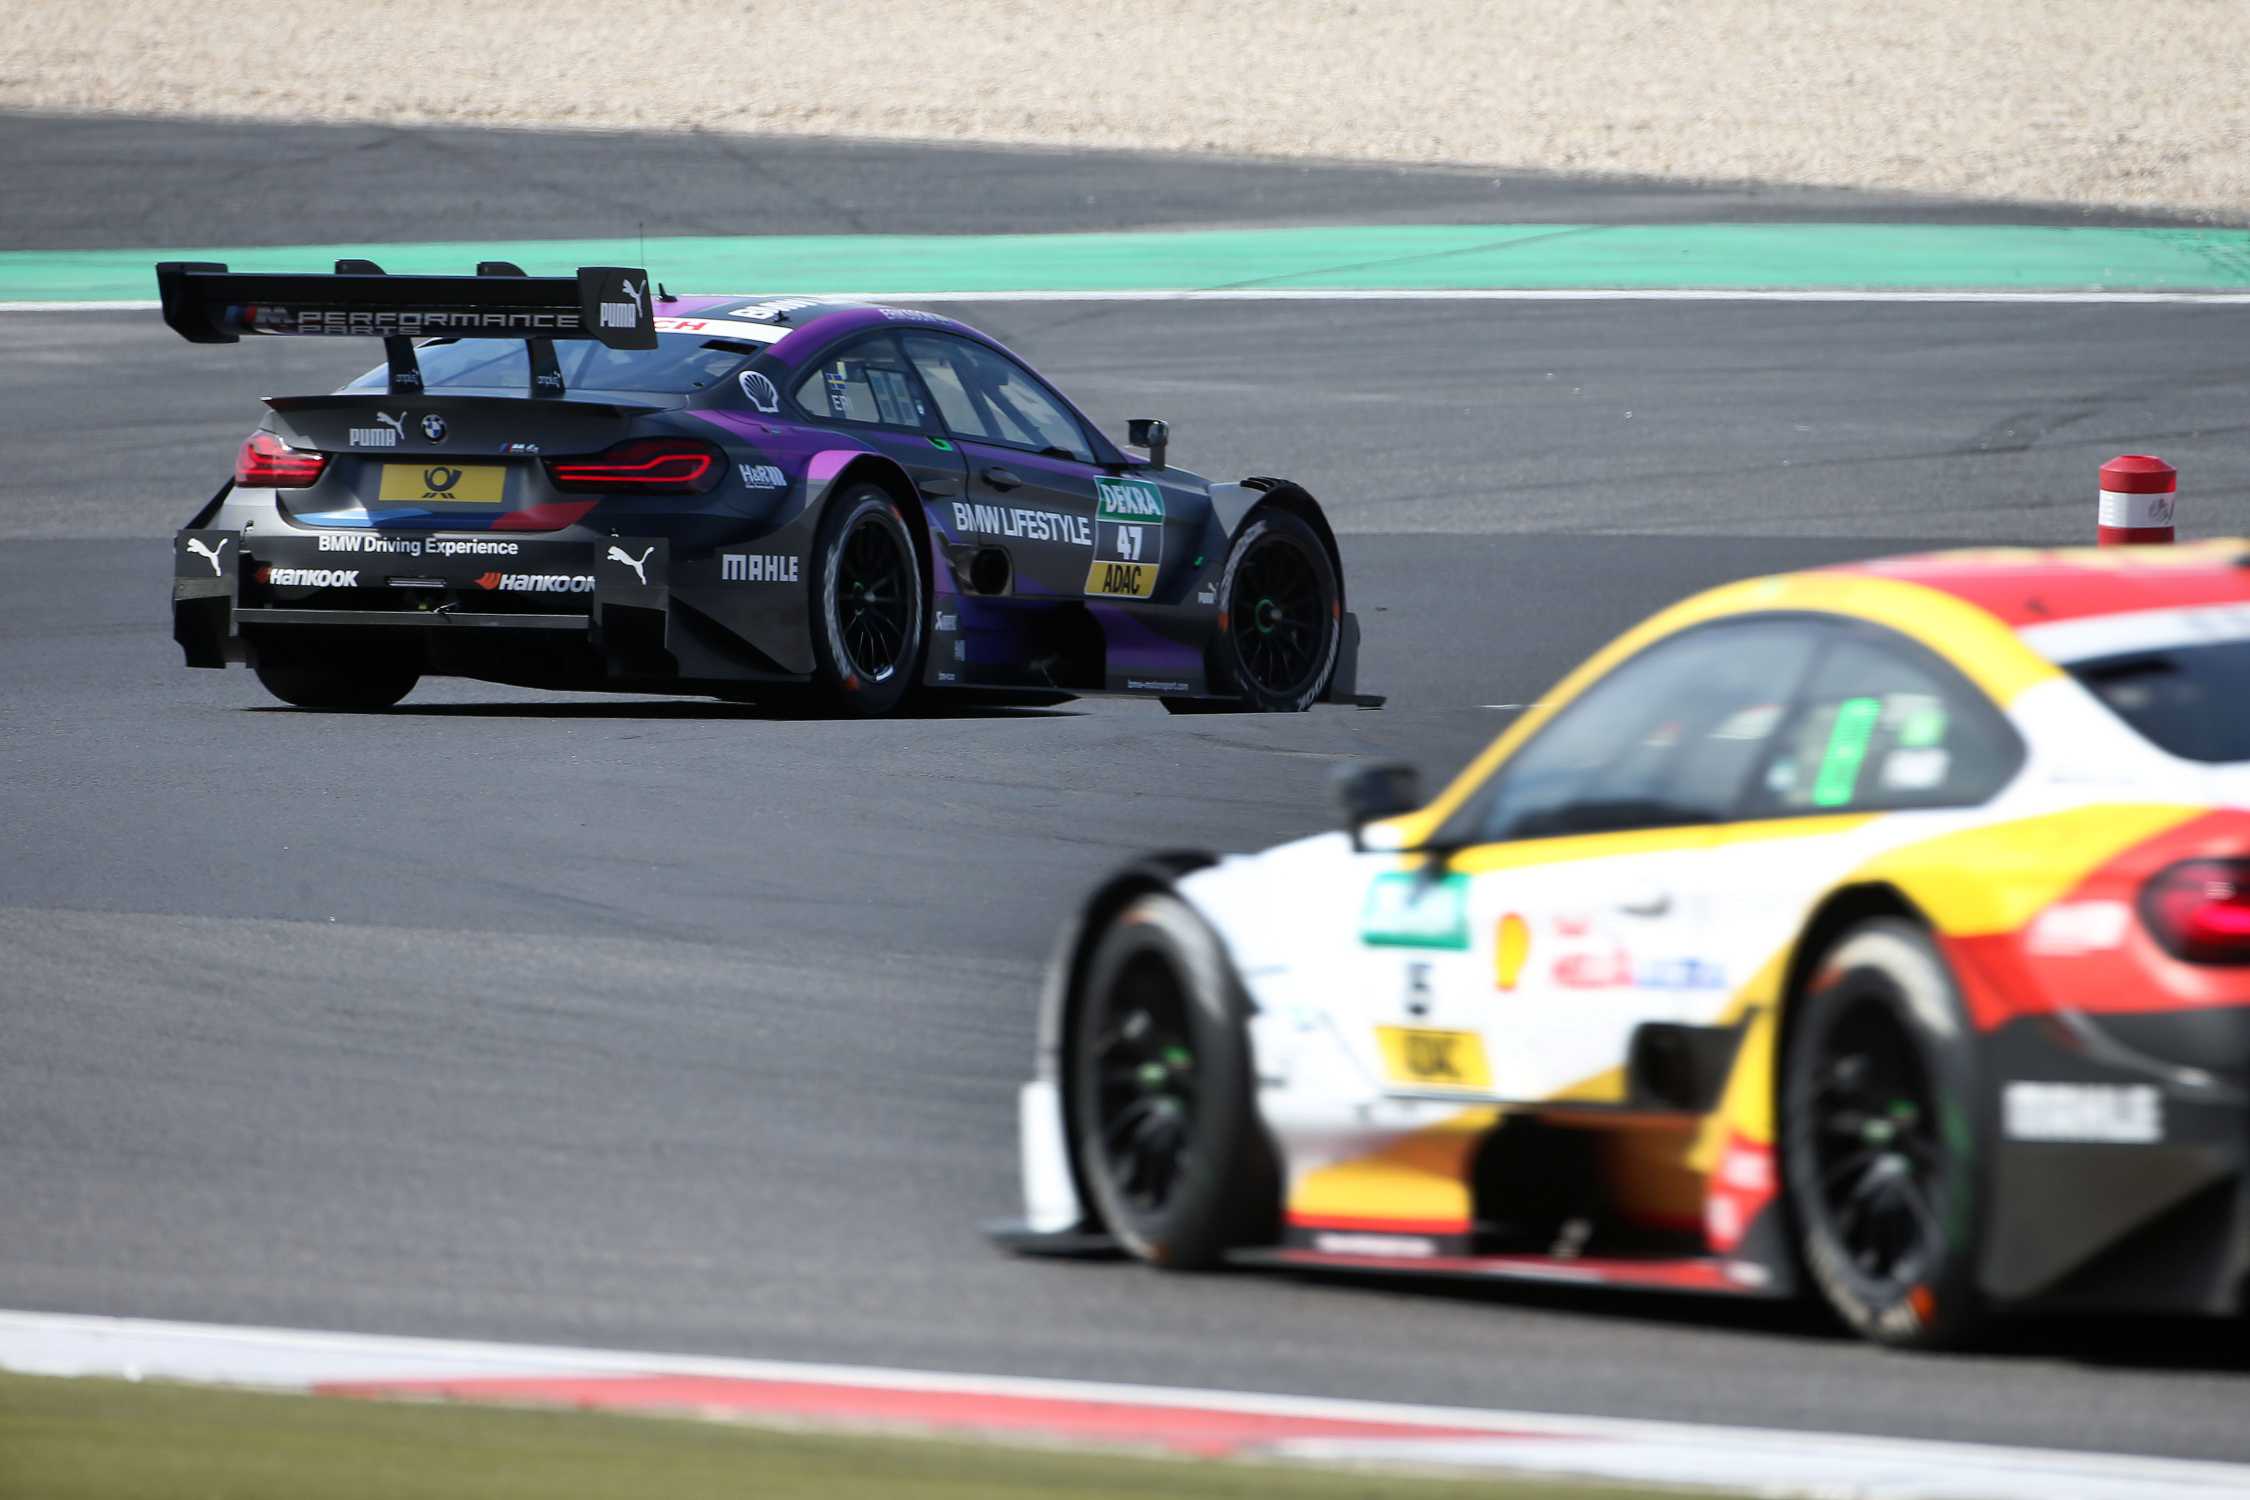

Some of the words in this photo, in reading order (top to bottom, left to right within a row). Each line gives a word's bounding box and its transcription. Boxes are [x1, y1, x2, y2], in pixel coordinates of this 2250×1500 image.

[299, 311, 580, 328] PERFORMANCE
[600, 302, 636, 328] PUMA
[349, 428, 396, 447] PUMA
[1100, 484, 1161, 516] DEKRA
[952, 502, 1000, 534] BMW
[1000, 508, 1093, 546] LIFESTYLE
[318, 535, 360, 552] BMW
[364, 537, 421, 556] Driving
[425, 538, 518, 557] Experience
[1117, 525, 1143, 561] 47
[721, 554, 799, 582] MAHLE
[1102, 564, 1142, 594] ADAC
